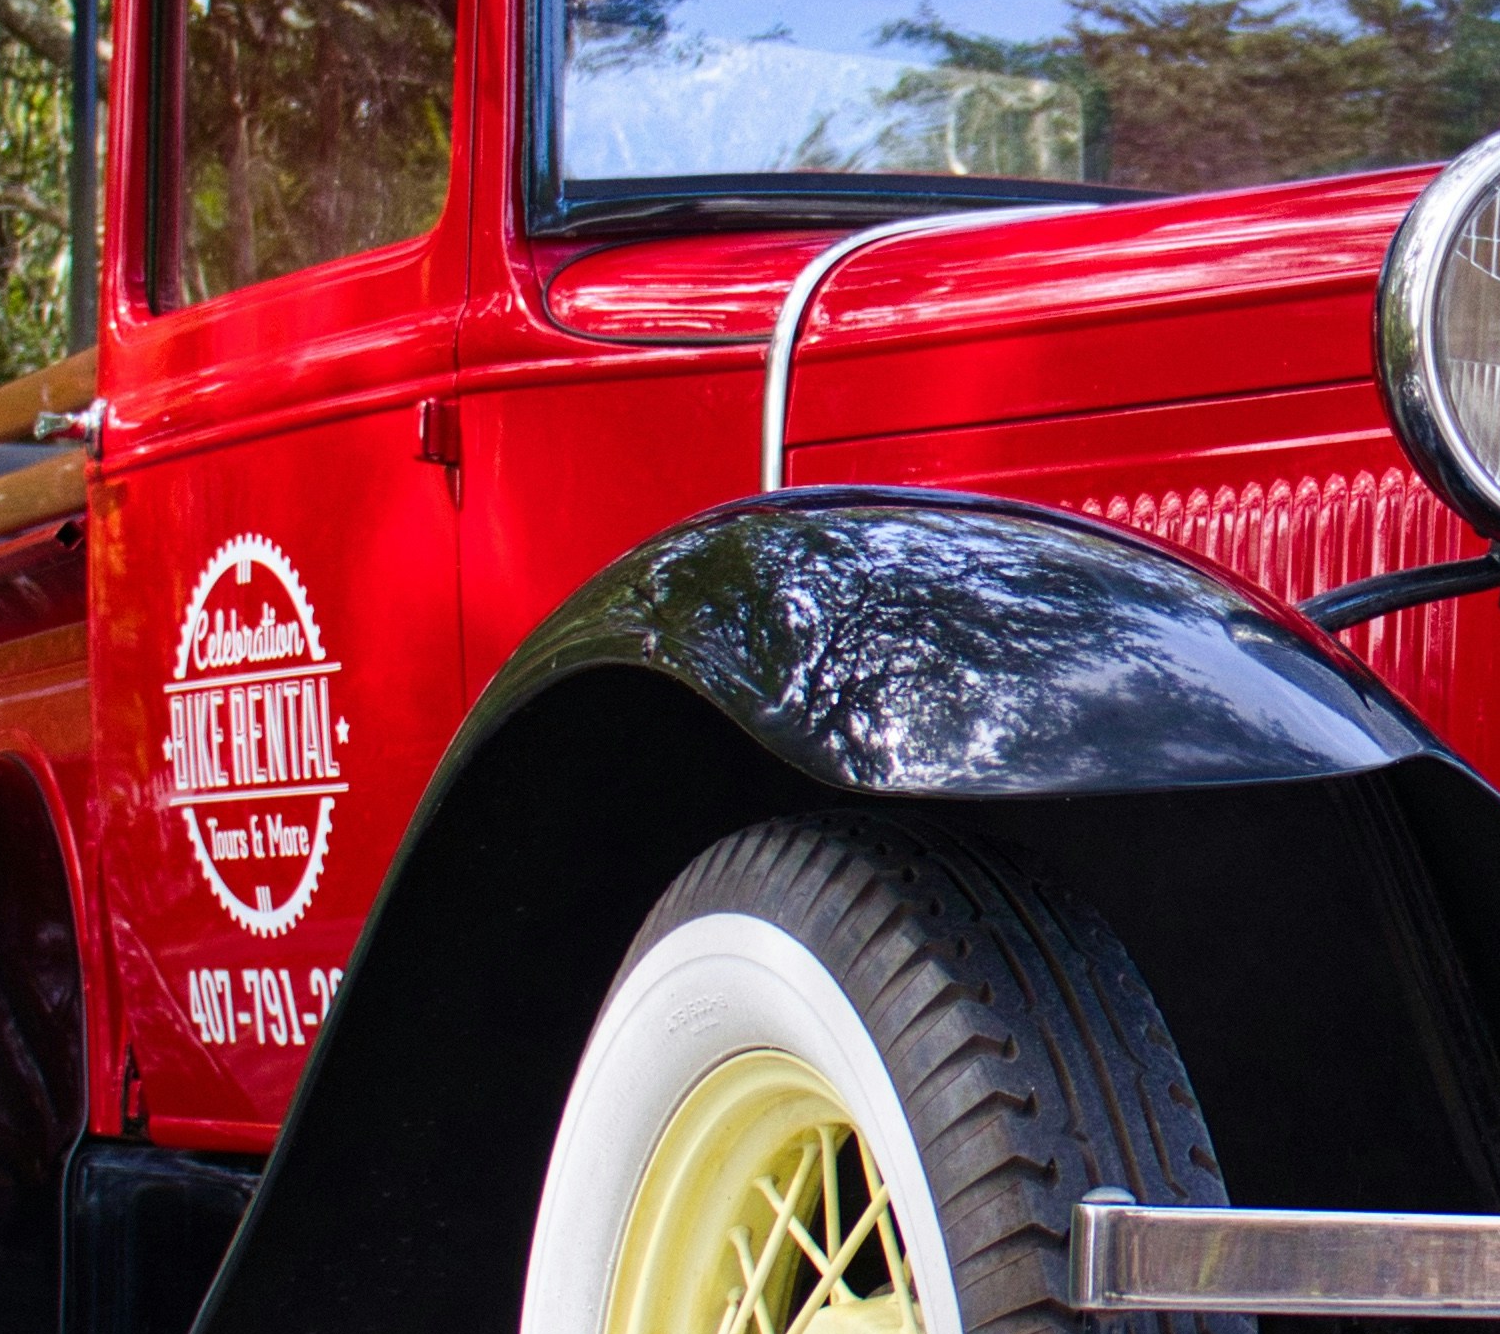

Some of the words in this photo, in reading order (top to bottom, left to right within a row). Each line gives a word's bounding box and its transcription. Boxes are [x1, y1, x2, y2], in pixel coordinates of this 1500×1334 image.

[193, 601, 305, 671] Celebration
[170, 689, 230, 791] BIKE
[229, 676, 341, 786] RENTAL
[206, 817, 250, 862] Tours
[250, 814, 265, 859] &
[265, 813, 310, 859] More
